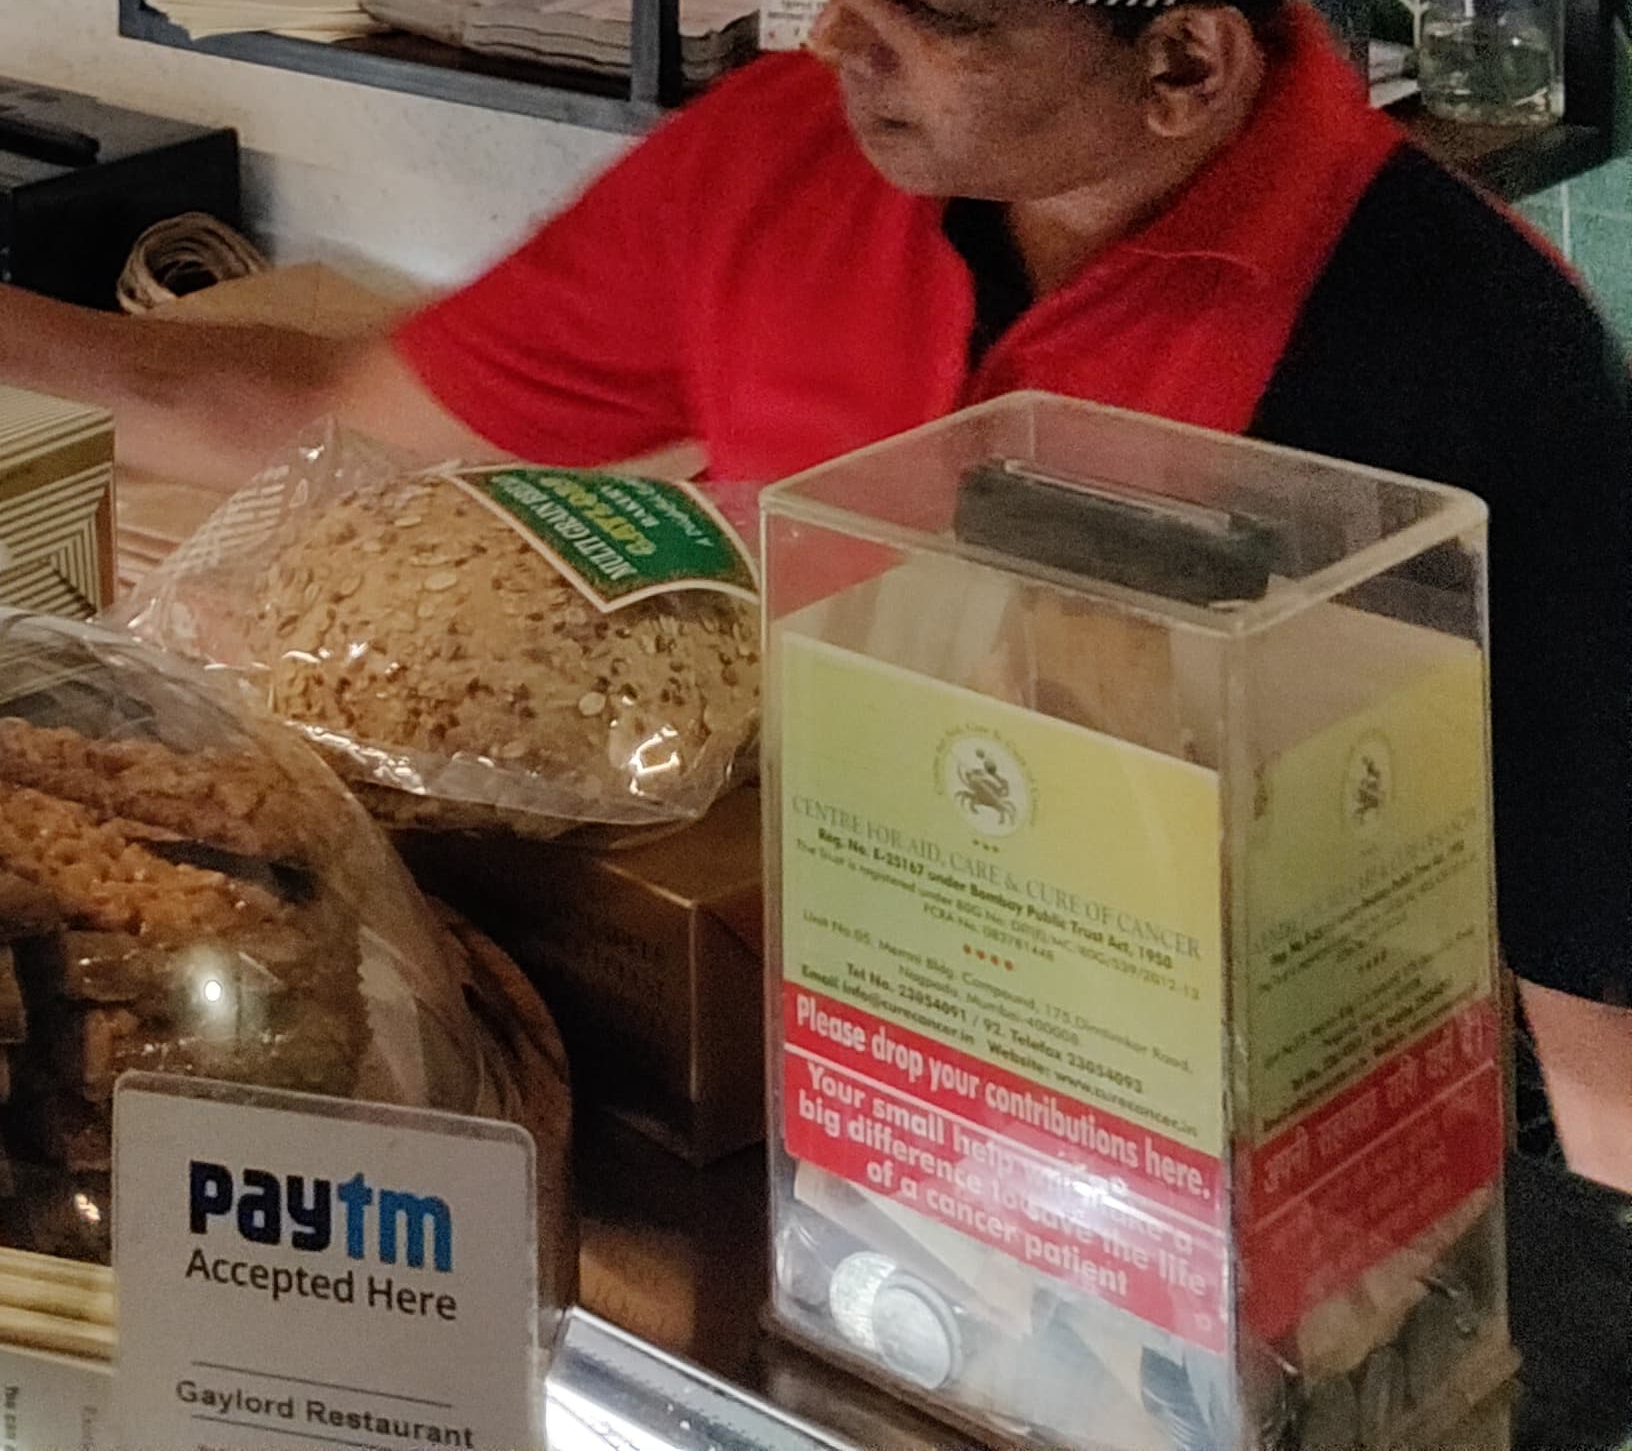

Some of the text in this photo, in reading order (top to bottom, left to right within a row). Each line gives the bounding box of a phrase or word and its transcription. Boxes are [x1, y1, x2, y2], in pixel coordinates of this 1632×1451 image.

[1069, 919, 1103, 944] Trust
[1116, 910, 1200, 962] CANCER
[796, 990, 1210, 1202] Please drop your contributions here.
[807, 1060, 863, 1111] Your
[871, 1094, 944, 1147] small
[189, 1159, 453, 1273] paytm
[798, 1088, 841, 1139] big
[847, 1110, 982, 1198] difference
[1102, 1223, 1148, 1272] the
[1158, 1248, 1206, 1299] life
[866, 1150, 1127, 1300] of a cancer patient
[186, 1247, 459, 1322] Accepted Here
[175, 1379, 474, 1450] Gaylord Restaurant
